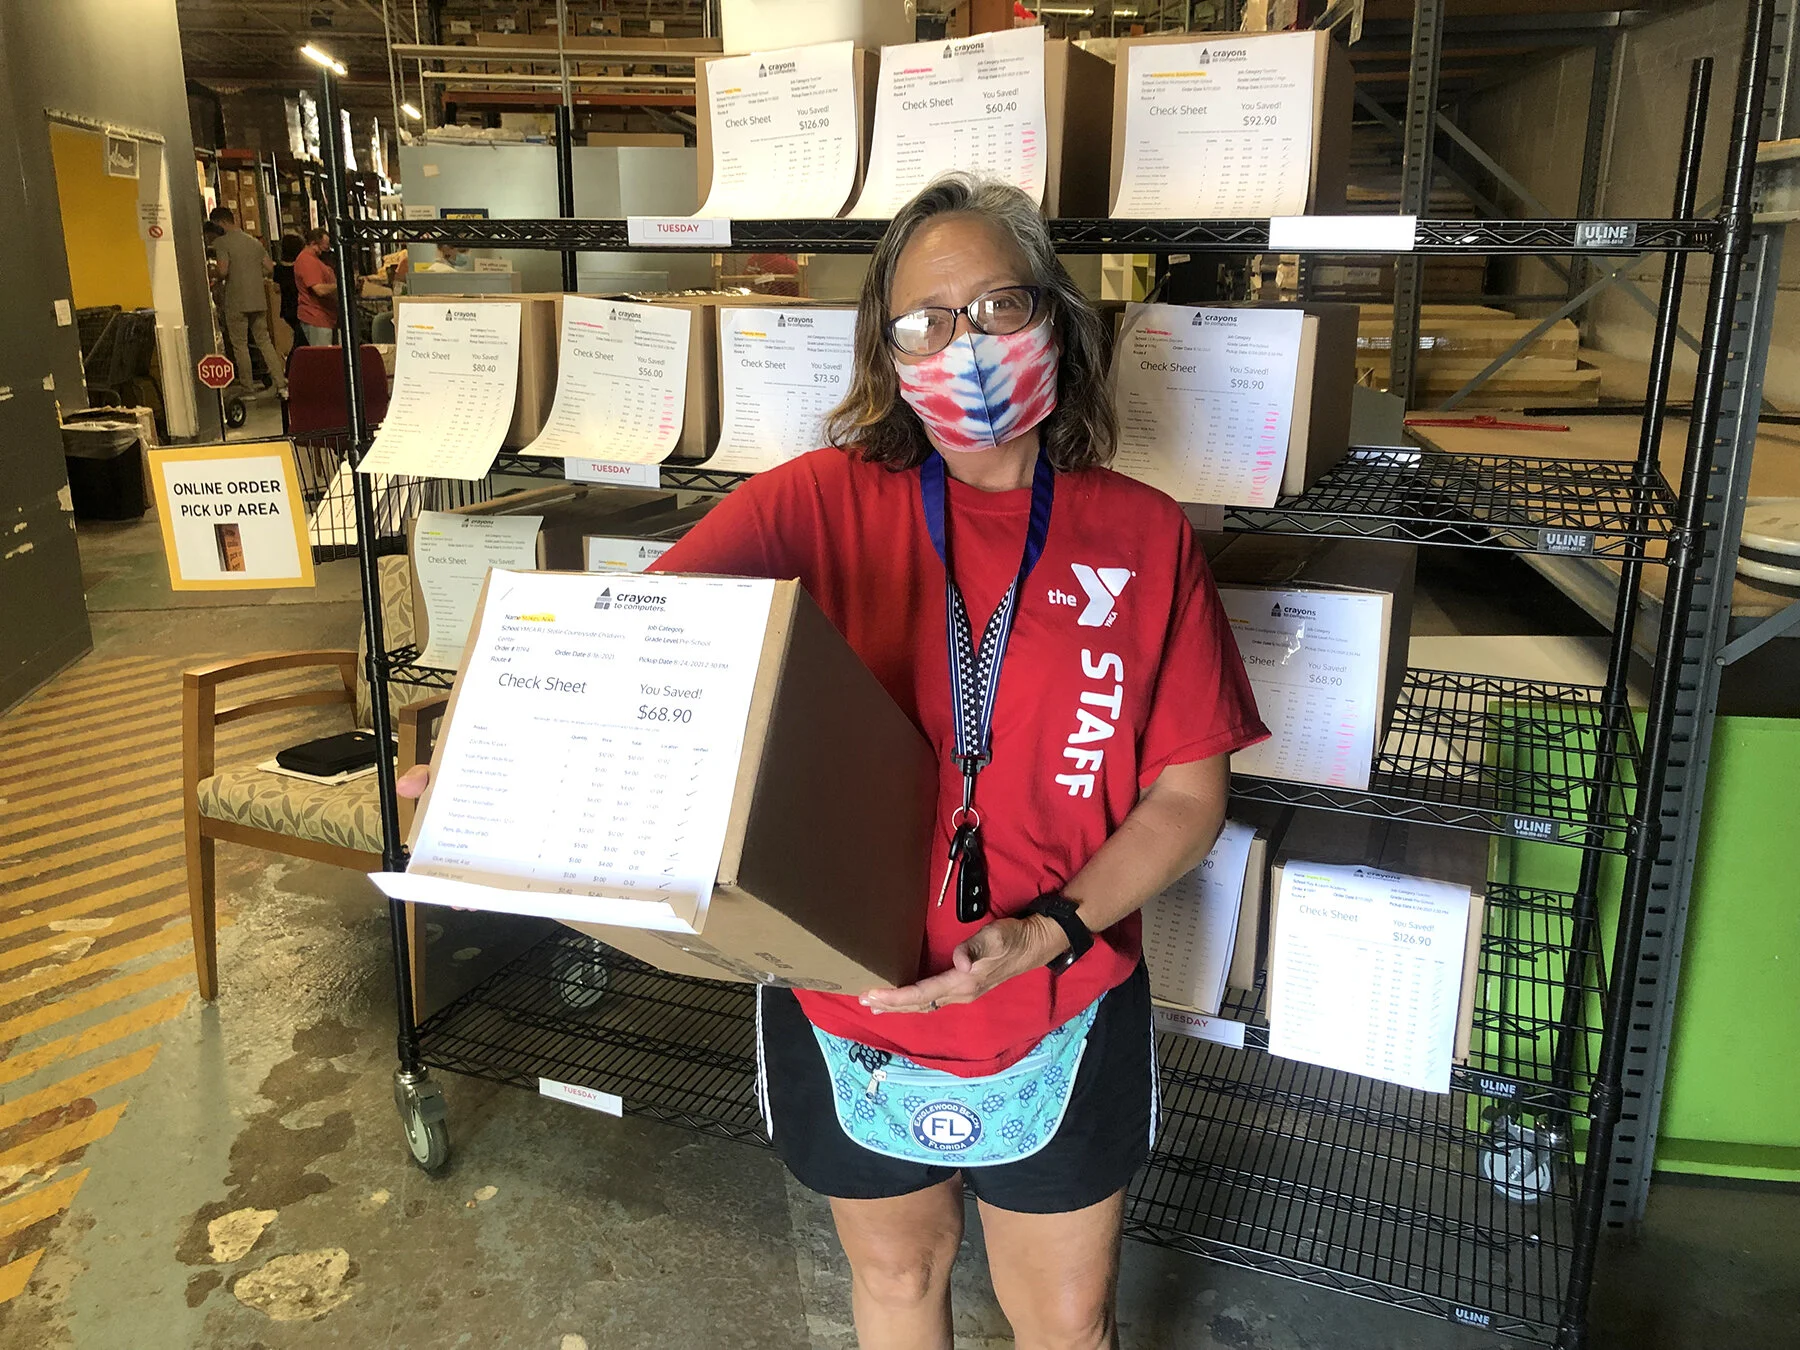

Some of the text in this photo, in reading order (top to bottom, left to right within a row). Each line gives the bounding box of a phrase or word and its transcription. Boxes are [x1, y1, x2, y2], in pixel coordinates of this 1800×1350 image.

[954, 42, 984, 52] crayons
[1213, 49, 1247, 59] crayons
[768, 61, 796, 71] crayons
[983, 88, 1019, 99] You Saved!
[902, 97, 954, 111] Check Sheet
[985, 102, 1017, 114] $60.40
[1241, 101, 1282, 111] You Saved!
[797, 105, 829, 116] You Saved!
[1149, 105, 1207, 116] Check Sheet
[725, 115, 771, 128] Check Sheet
[799, 118, 830, 130] $126.90
[1243, 115, 1277, 126] $92.90
[657, 224, 699, 233] TUESDAY
[1585, 226, 1629, 238] ULINE
[453, 311, 477, 319] crayons
[618, 311, 641, 319] crayons
[787, 316, 814, 324] crayons
[1205, 313, 1238, 323] crayons
[411, 350, 450, 360] Check Sheet
[573, 348, 614, 361] Check Sheet
[637, 356, 665, 366] You Saved!
[741, 359, 786, 370] Check Sheet
[823, 362, 842, 370] Saved!
[201, 365, 231, 378] STOP
[473, 363, 496, 373] $80.40
[638, 367, 663, 378] $56.00
[1140, 361, 1197, 374] Check Sheet
[1229, 365, 1269, 375] You Saved!
[813, 373, 840, 383] $73.50
[1230, 378, 1264, 390] $98.90
[591, 464, 631, 474] TUESDAY
[173, 480, 281, 496] ONLINE ORDER
[181, 502, 280, 517] PICK UP AREA
[471, 518, 494, 526] crayons
[1546, 533, 1586, 547] ULINE
[428, 556, 467, 565] Check Sheet
[500, 558, 515, 566] Saved!
[616, 593, 667, 605] crayons
[1047, 589, 1077, 607] the
[623, 603, 666, 612] computers.
[1284, 606, 1317, 617] crayons
[658, 625, 684, 633] Category
[555, 649, 571, 657] Order
[638, 656, 658, 664] Pickup
[1249, 655, 1276, 668] Sheet
[1308, 661, 1347, 673] You Saved!
[498, 672, 587, 694] Check Sheet
[1309, 674, 1343, 687] $68.90
[640, 683, 703, 699] You Saved!
[637, 704, 692, 723] $68.90
[1055, 648, 1124, 798] STAFF
[1514, 819, 1552, 834] ULINE
[1299, 904, 1358, 923] Check Sheet
[1393, 919, 1435, 932] You Saved!
[1392, 931, 1431, 946] $126.90
[1159, 1011, 1209, 1028] TUESDAY
[1480, 1079, 1516, 1095] ULINE
[563, 1086, 597, 1100] TUESDAY
[914, 1103, 980, 1129] ENGLEWOOD BEACH
[932, 1117, 965, 1136] FL
[928, 1140, 967, 1150] FLORIDA
[1455, 1308, 1490, 1325] ULINE
